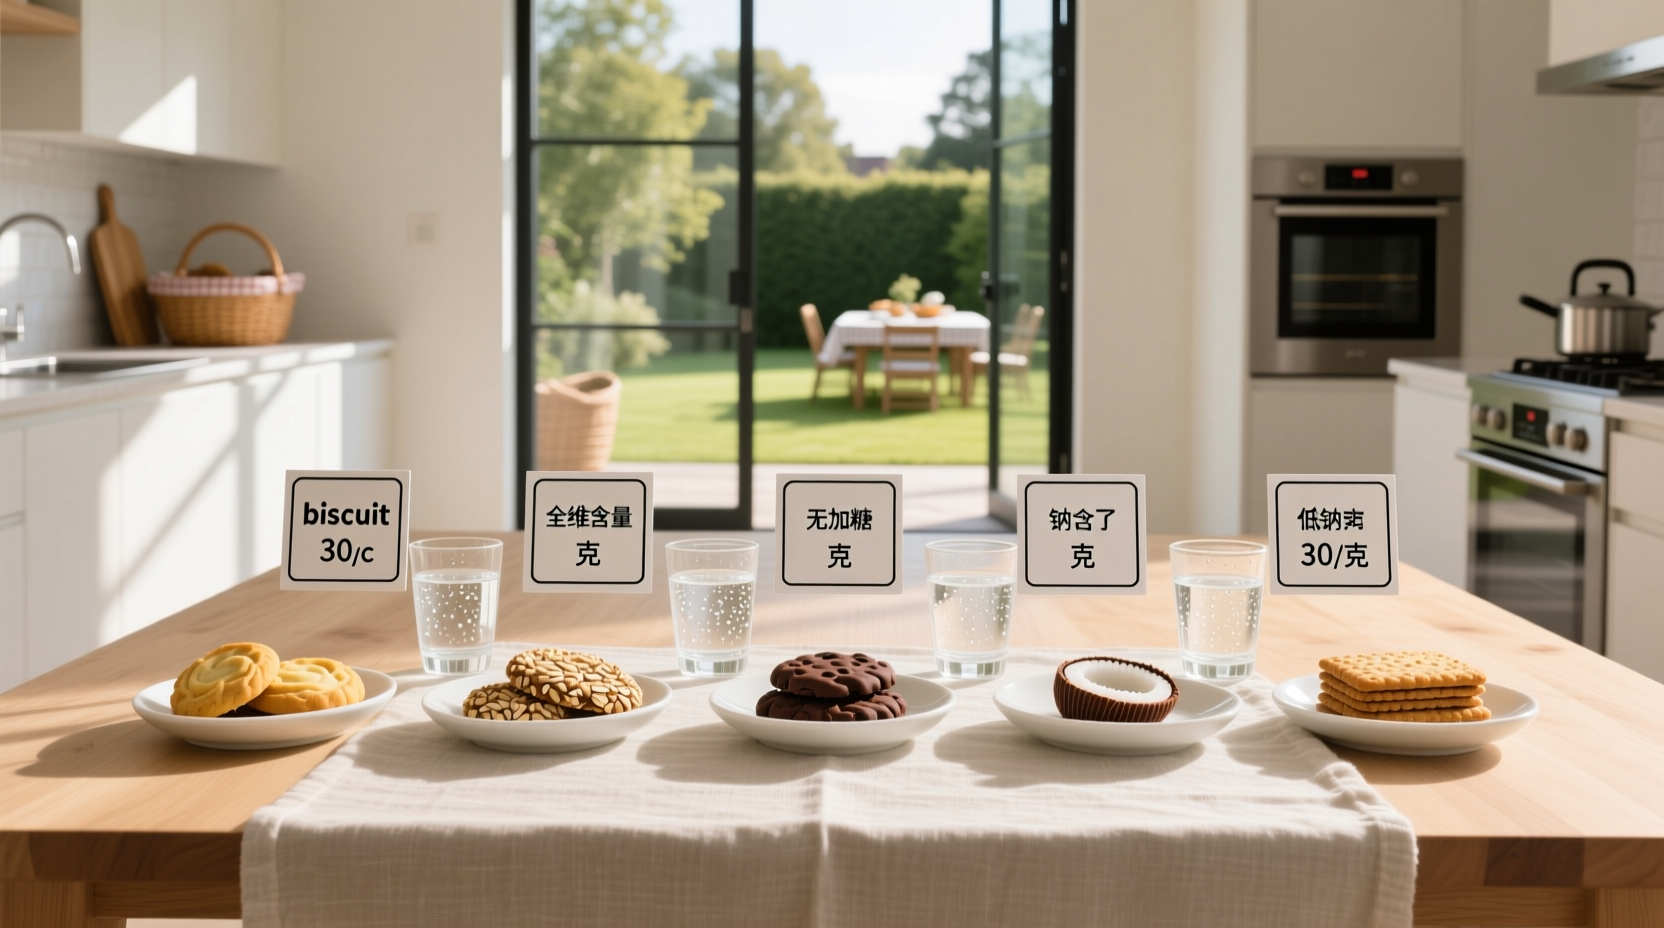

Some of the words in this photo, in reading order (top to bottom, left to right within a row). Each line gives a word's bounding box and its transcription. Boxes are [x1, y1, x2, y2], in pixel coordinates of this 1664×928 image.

[304, 501, 391, 526] biscuit
[806, 507, 873, 531] 无加糖
[575, 540, 601, 567] 克
[827, 542, 852, 569] 克
[1070, 543, 1096, 569] 克
[1300, 541, 1369, 570] 30/克
